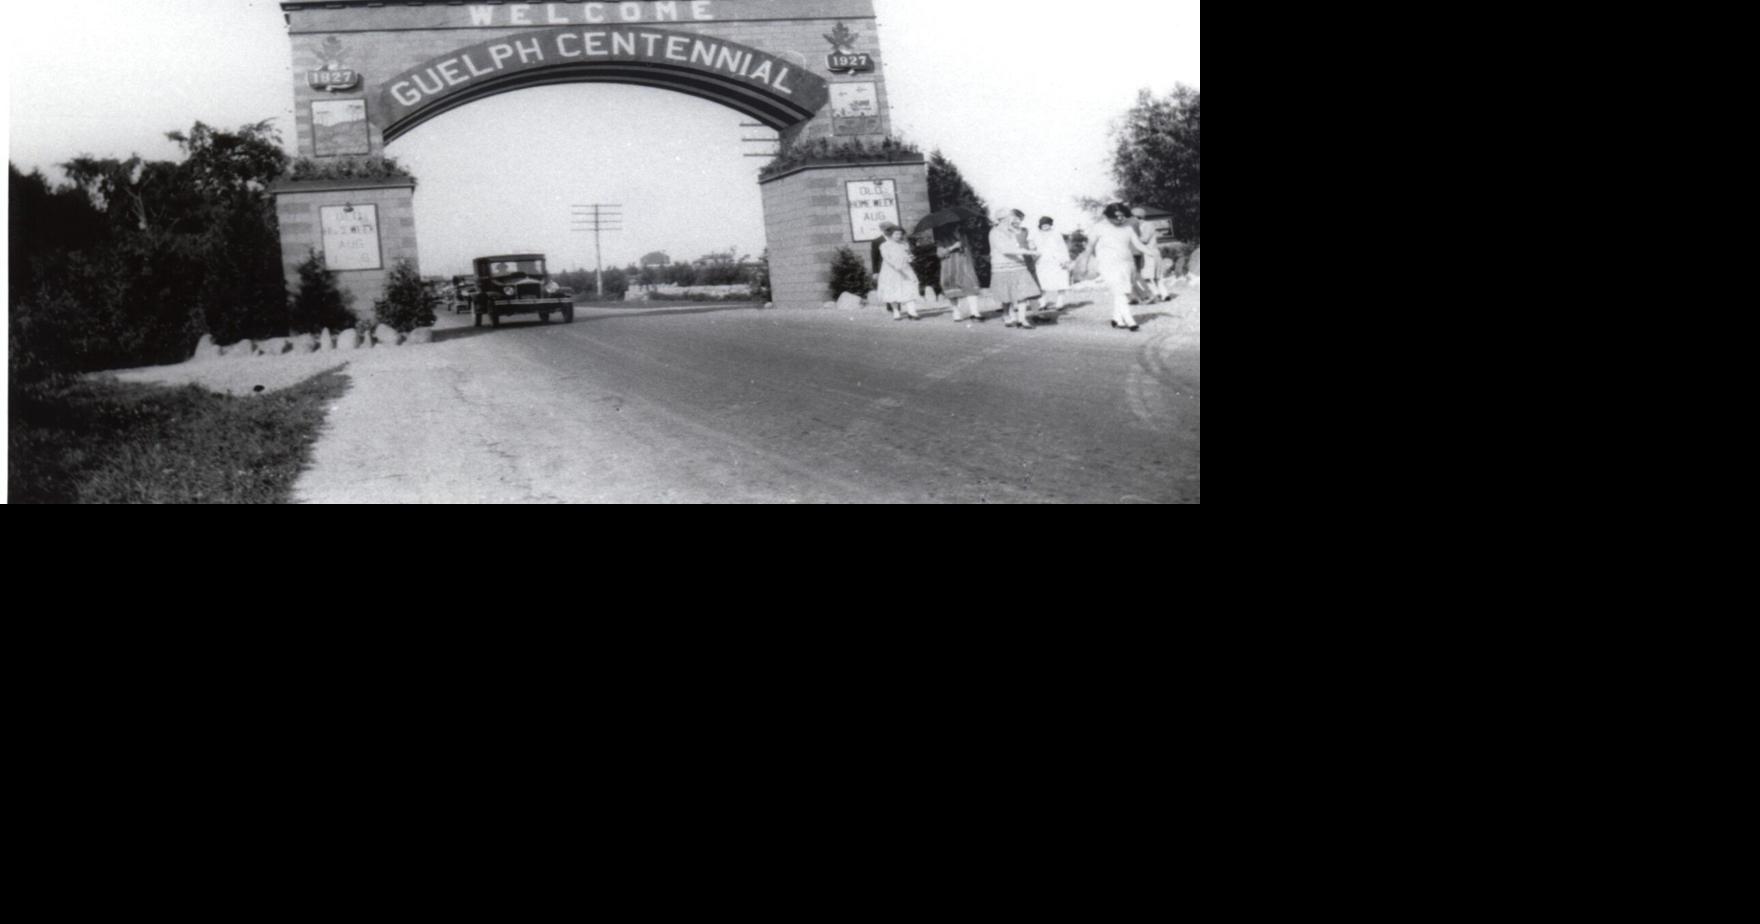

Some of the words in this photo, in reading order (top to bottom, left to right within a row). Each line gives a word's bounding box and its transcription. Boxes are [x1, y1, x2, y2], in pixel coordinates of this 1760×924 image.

[469, 1, 715, 26] WELCOME
[832, 55, 867, 67] 1927
[390, 37, 544, 106] GUELPH
[556, 31, 792, 94] CENTENNIAL
[863, 211, 886, 221] AUG
[339, 238, 365, 249] AUG
